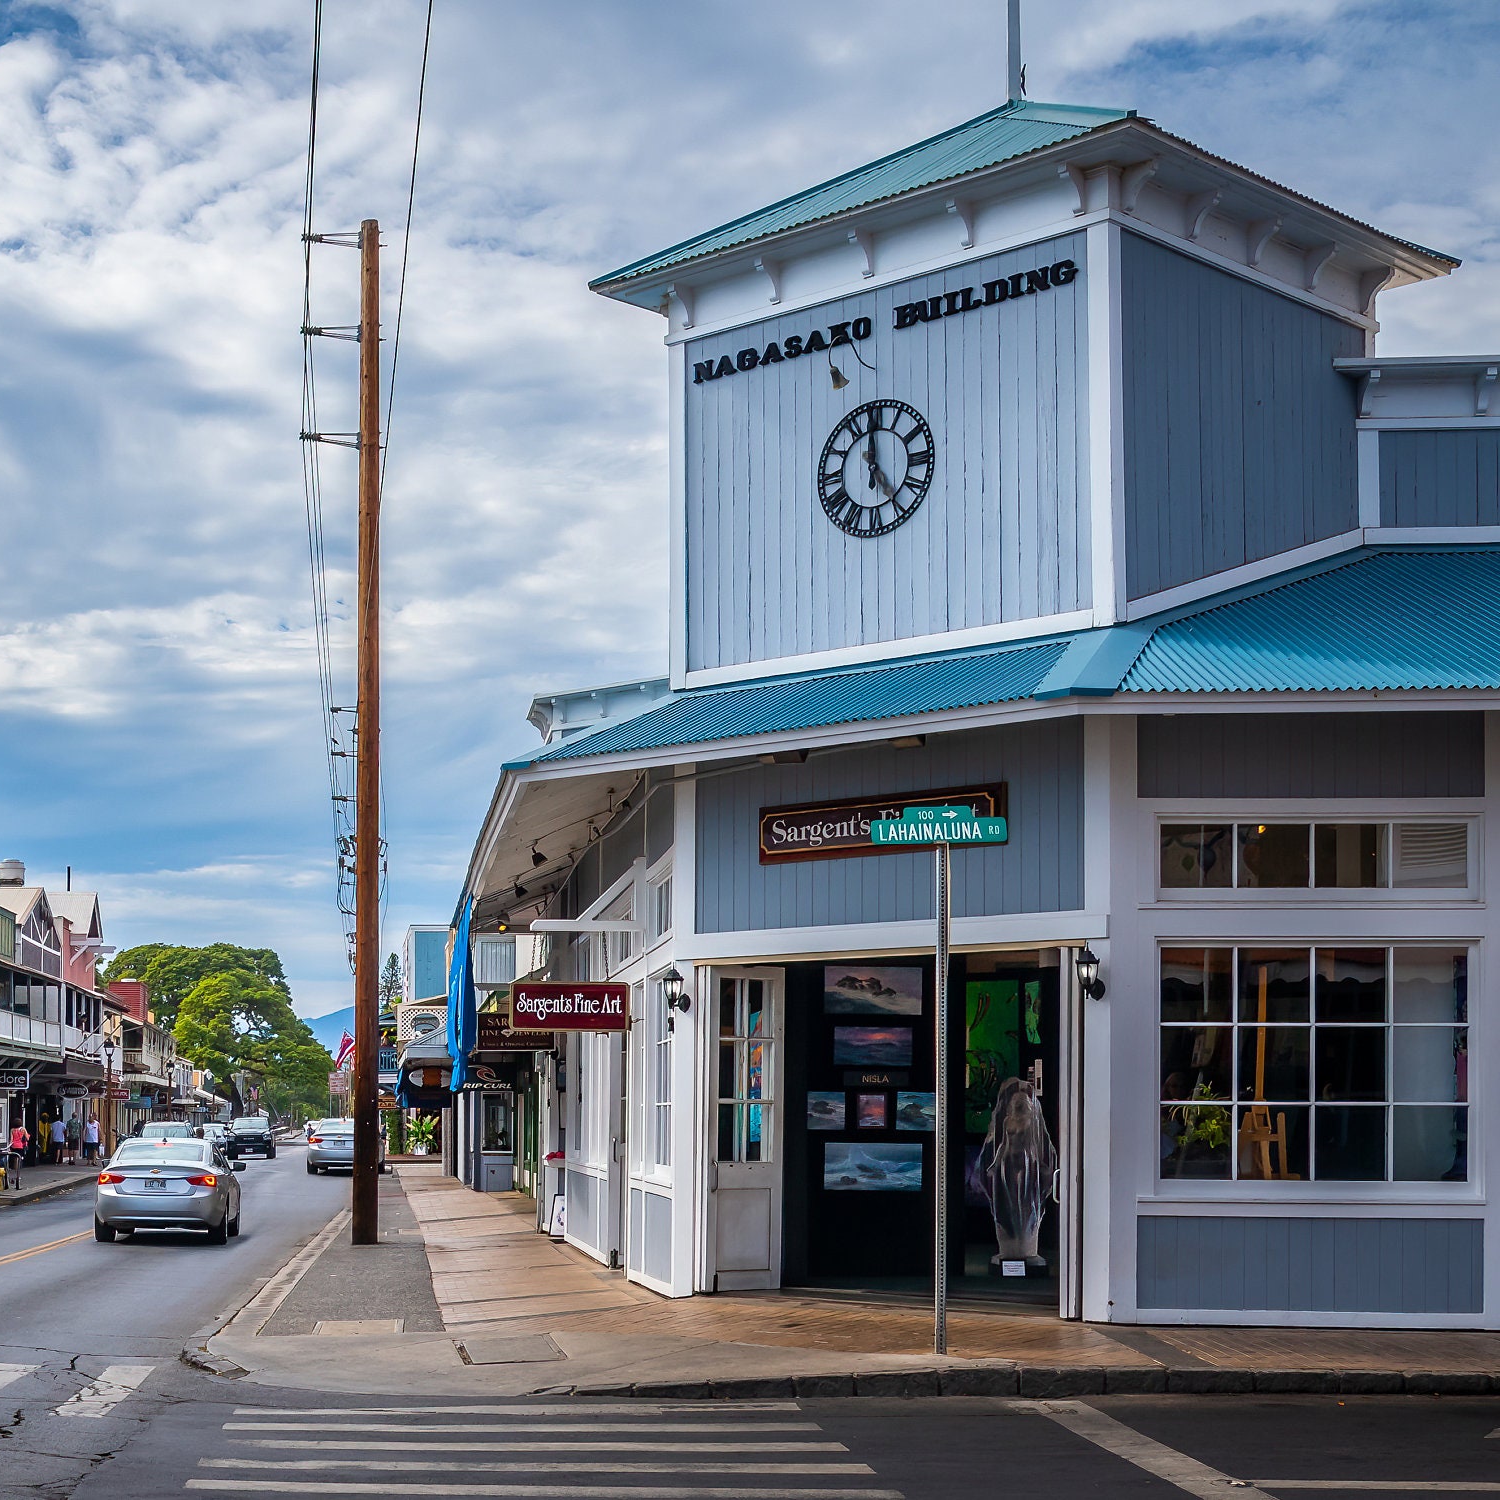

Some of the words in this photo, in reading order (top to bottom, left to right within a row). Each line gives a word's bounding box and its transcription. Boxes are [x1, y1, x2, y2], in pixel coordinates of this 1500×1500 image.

[692, 316, 873, 385] NAGASAKO
[892, 258, 1080, 331] BUILDING
[917, 811, 934, 820] 100
[771, 812, 871, 846] Sargent's
[878, 822, 983, 841] LAHAINALUNA
[988, 825, 1000, 835] RD
[516, 992, 573, 1020] Sargent's
[574, 993, 600, 1013] Fine
[601, 993, 622, 1013] Art
[487, 1017, 509, 1027] SAR
[862, 1075, 889, 1083] NISLA
